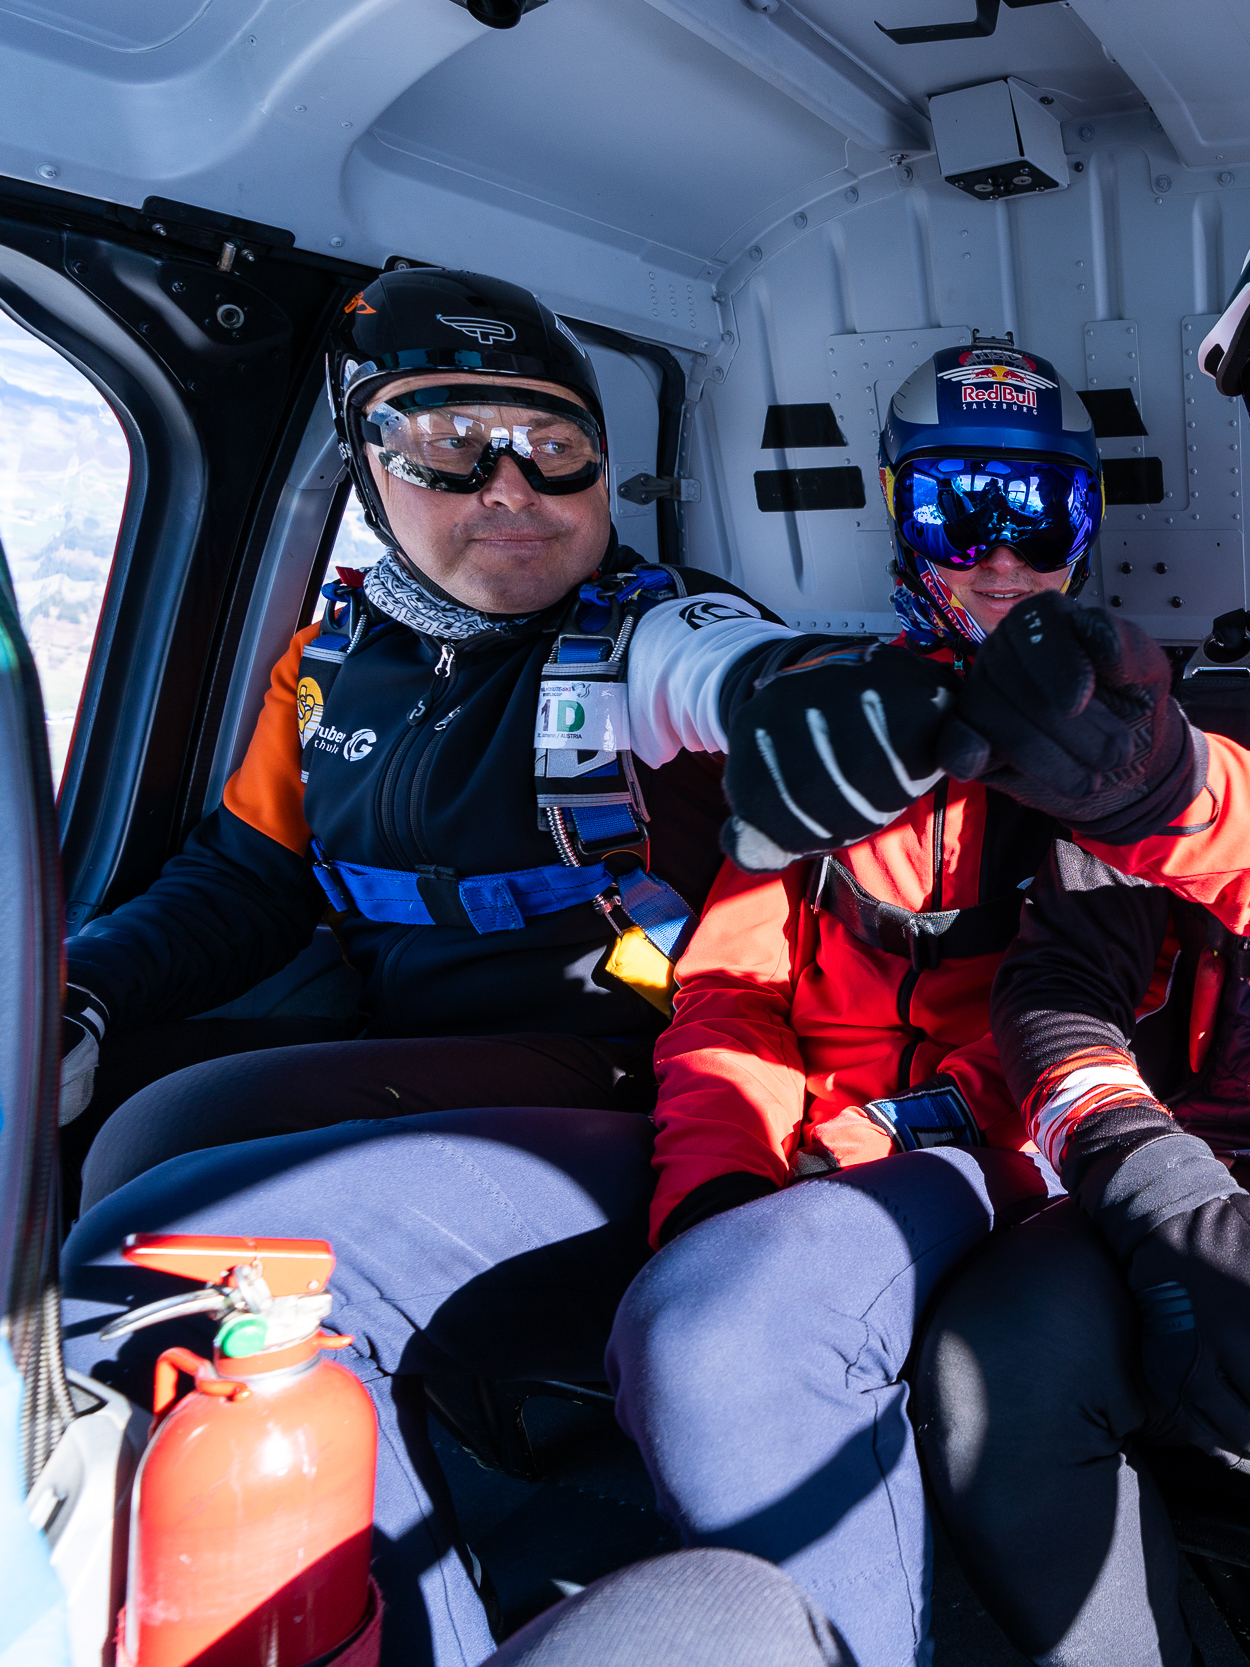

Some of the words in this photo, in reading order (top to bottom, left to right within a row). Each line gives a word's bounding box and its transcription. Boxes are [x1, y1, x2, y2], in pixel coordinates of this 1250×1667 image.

[973, 352, 1018, 361] HSV
[962, 384, 1000, 403] Red
[1001, 385, 1037, 408] Bull
[962, 402, 1038, 416] SALZBURG
[920, 569, 949, 610] Red
